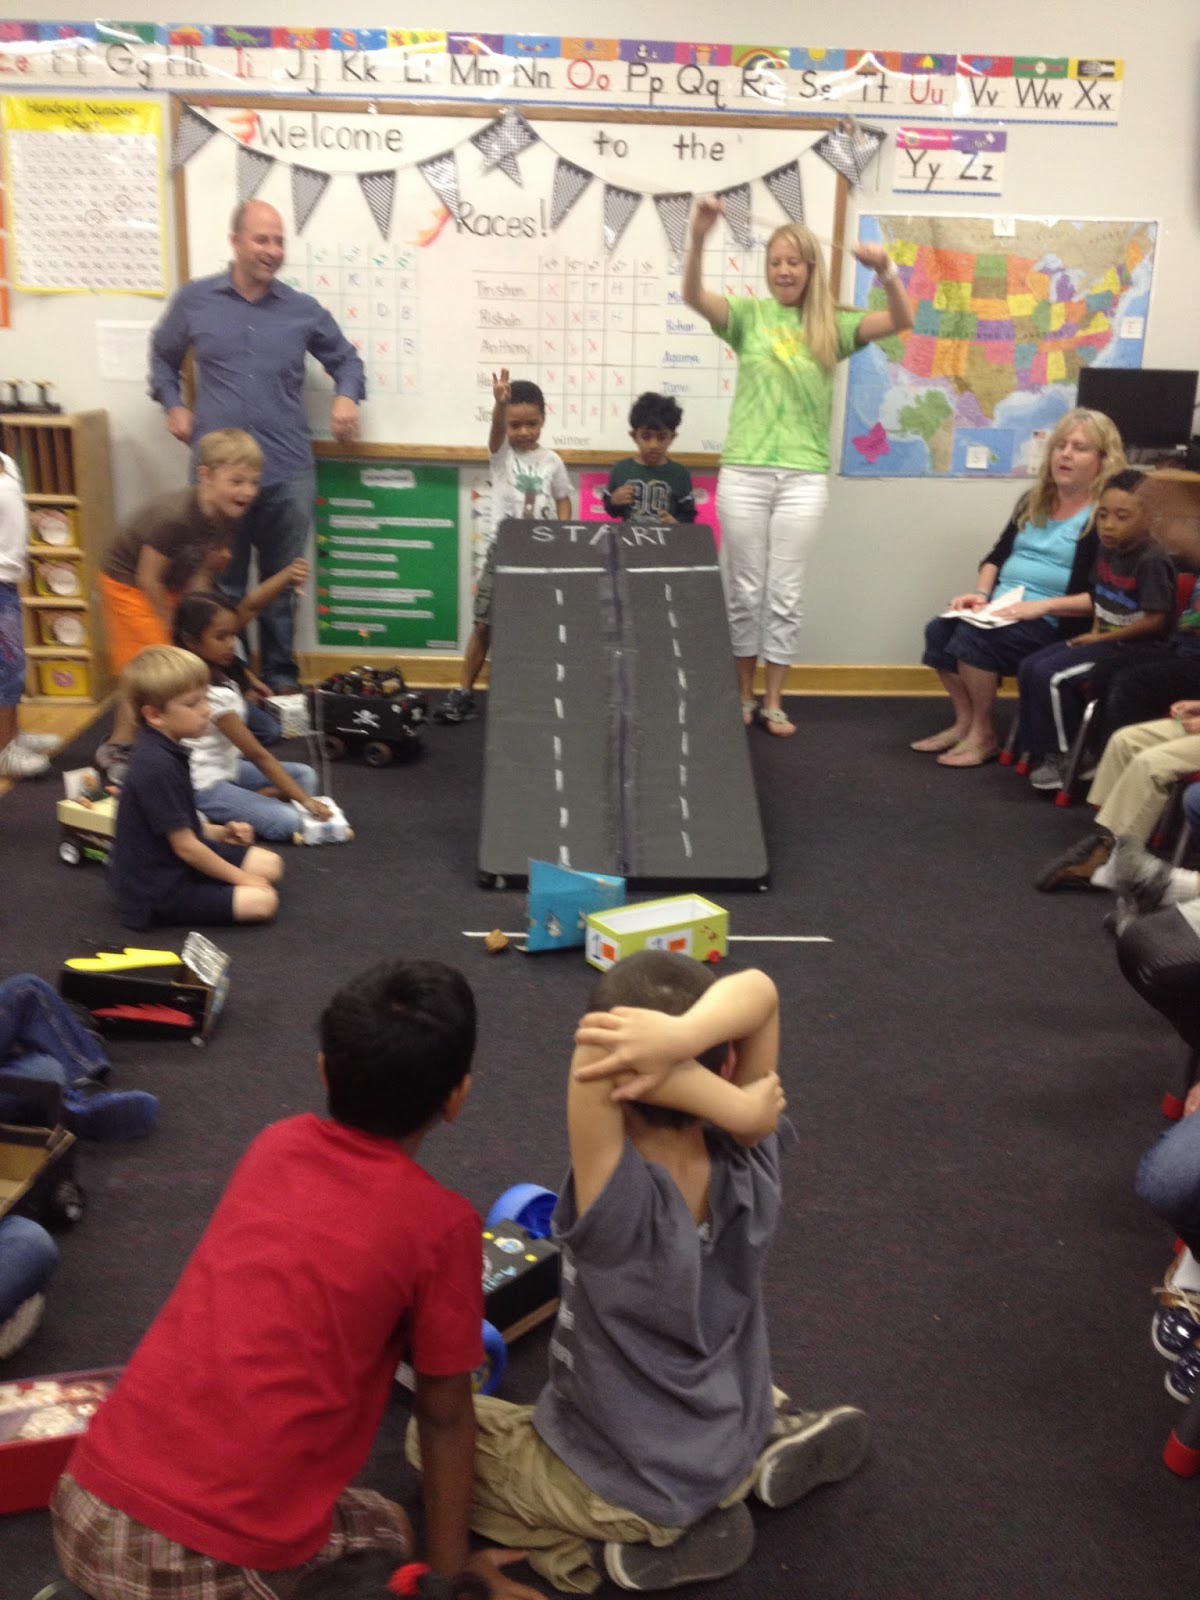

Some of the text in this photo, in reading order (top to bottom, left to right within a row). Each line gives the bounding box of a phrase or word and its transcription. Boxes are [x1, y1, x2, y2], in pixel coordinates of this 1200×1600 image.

[286, 49, 322, 94] Jj
[341, 50, 379, 81] Kk
[451, 55, 500, 86] Mm
[513, 57, 551, 88] Nn
[567, 59, 610, 90] Oo
[626, 62, 664, 105] Pp
[676, 64, 726, 110] Qq
[909, 77, 944, 105] Uu
[969, 78, 998, 107] Vv
[1015, 78, 1062, 108] Ww
[1076, 79, 1111, 110] Xx
[257, 113, 725, 162] Welcome to the
[906, 149, 993, 191] Yy Zz
[455, 197, 548, 239] Races!
[532, 524, 673, 546] START
